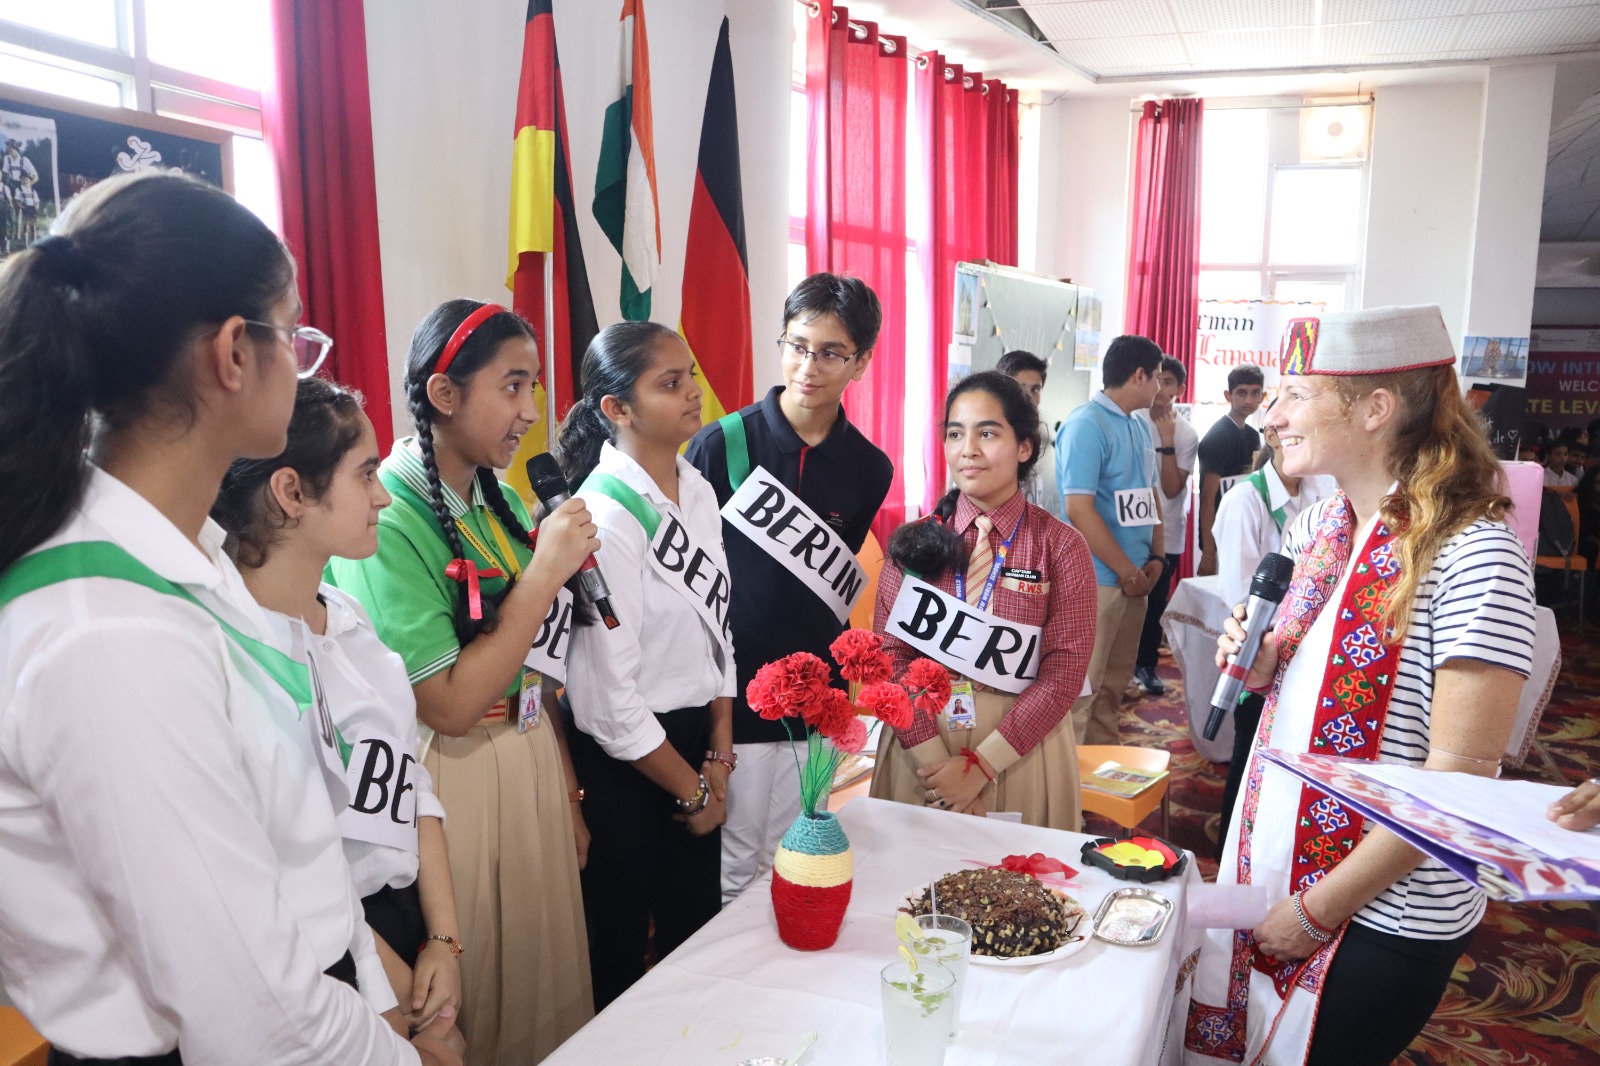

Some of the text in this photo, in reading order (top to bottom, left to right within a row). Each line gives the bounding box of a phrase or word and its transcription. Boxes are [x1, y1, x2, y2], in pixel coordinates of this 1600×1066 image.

[1525, 399, 1600, 415] TE LEV
[1559, 380, 1600, 392] WELC
[653, 511, 729, 641] BER
[736, 480, 862, 607] BERLIN
[982, 582, 993, 602] WORLD
[989, 562, 1001, 581] SCHOOL
[531, 595, 573, 666] BE
[348, 738, 417, 829] BE
